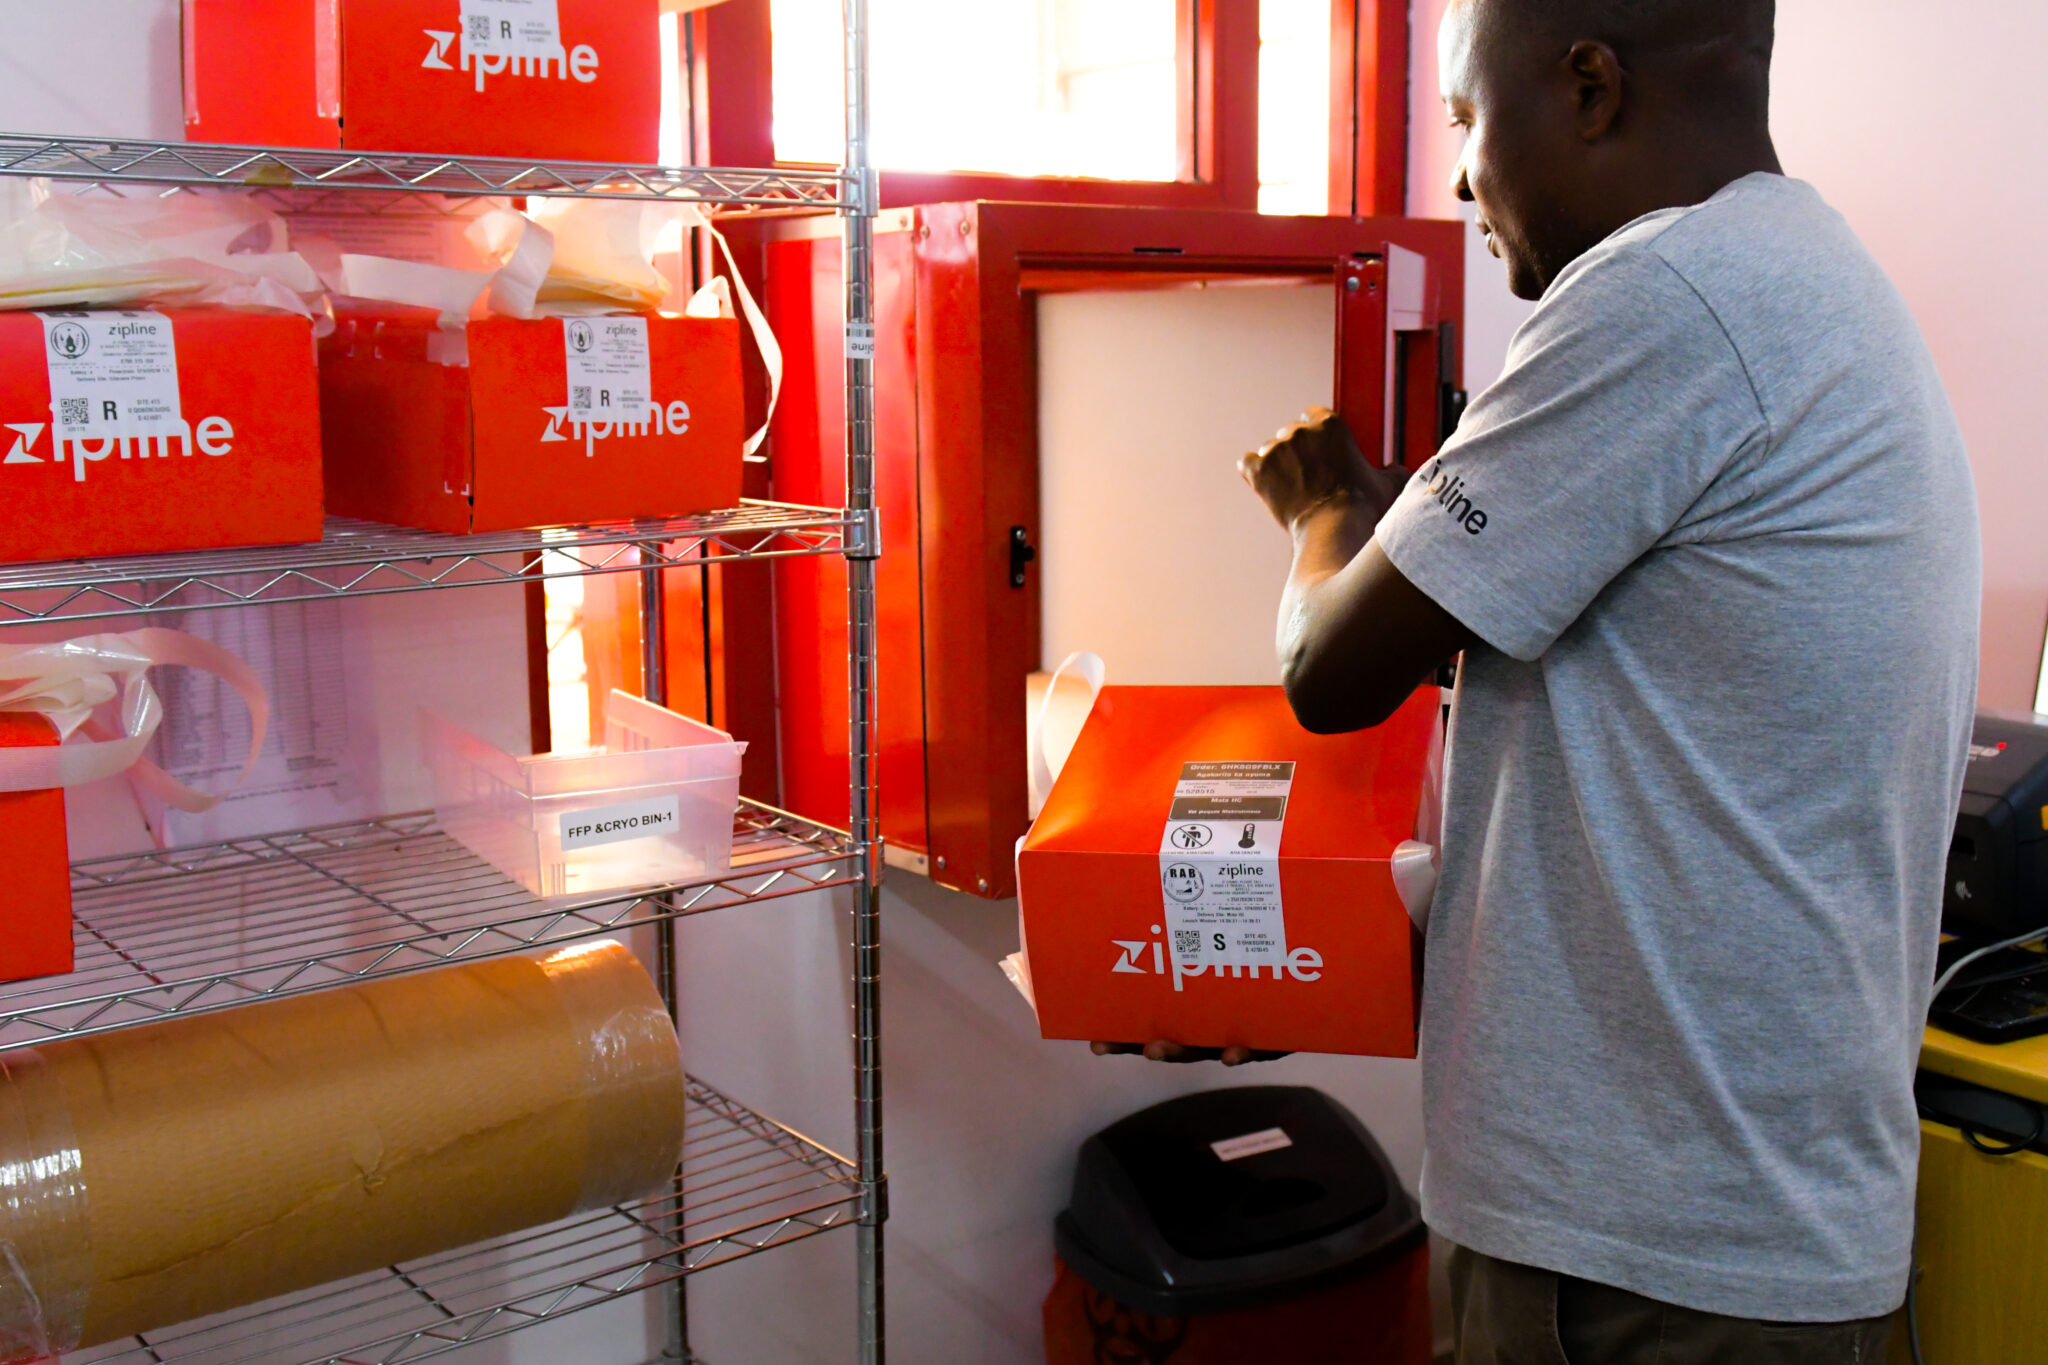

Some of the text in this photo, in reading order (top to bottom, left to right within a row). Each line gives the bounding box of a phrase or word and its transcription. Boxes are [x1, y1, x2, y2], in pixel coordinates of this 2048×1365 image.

[500, 20, 512, 39] R
[421, 15, 599, 92] zpne
[109, 322, 157, 339] zipline
[605, 324, 638, 337] zipline
[601, 389, 610, 407] R
[103, 400, 118, 420] R
[540, 400, 690, 458] zpne
[3, 402, 234, 482] zipne
[1420, 459, 1488, 535] ipline
[568, 811, 672, 838] FFP &CRYO BIN-1
[1170, 868, 1196, 878] RAB
[1218, 864, 1264, 879] zipline
[1213, 933, 1226, 951] S
[1111, 924, 1324, 992] zipe
